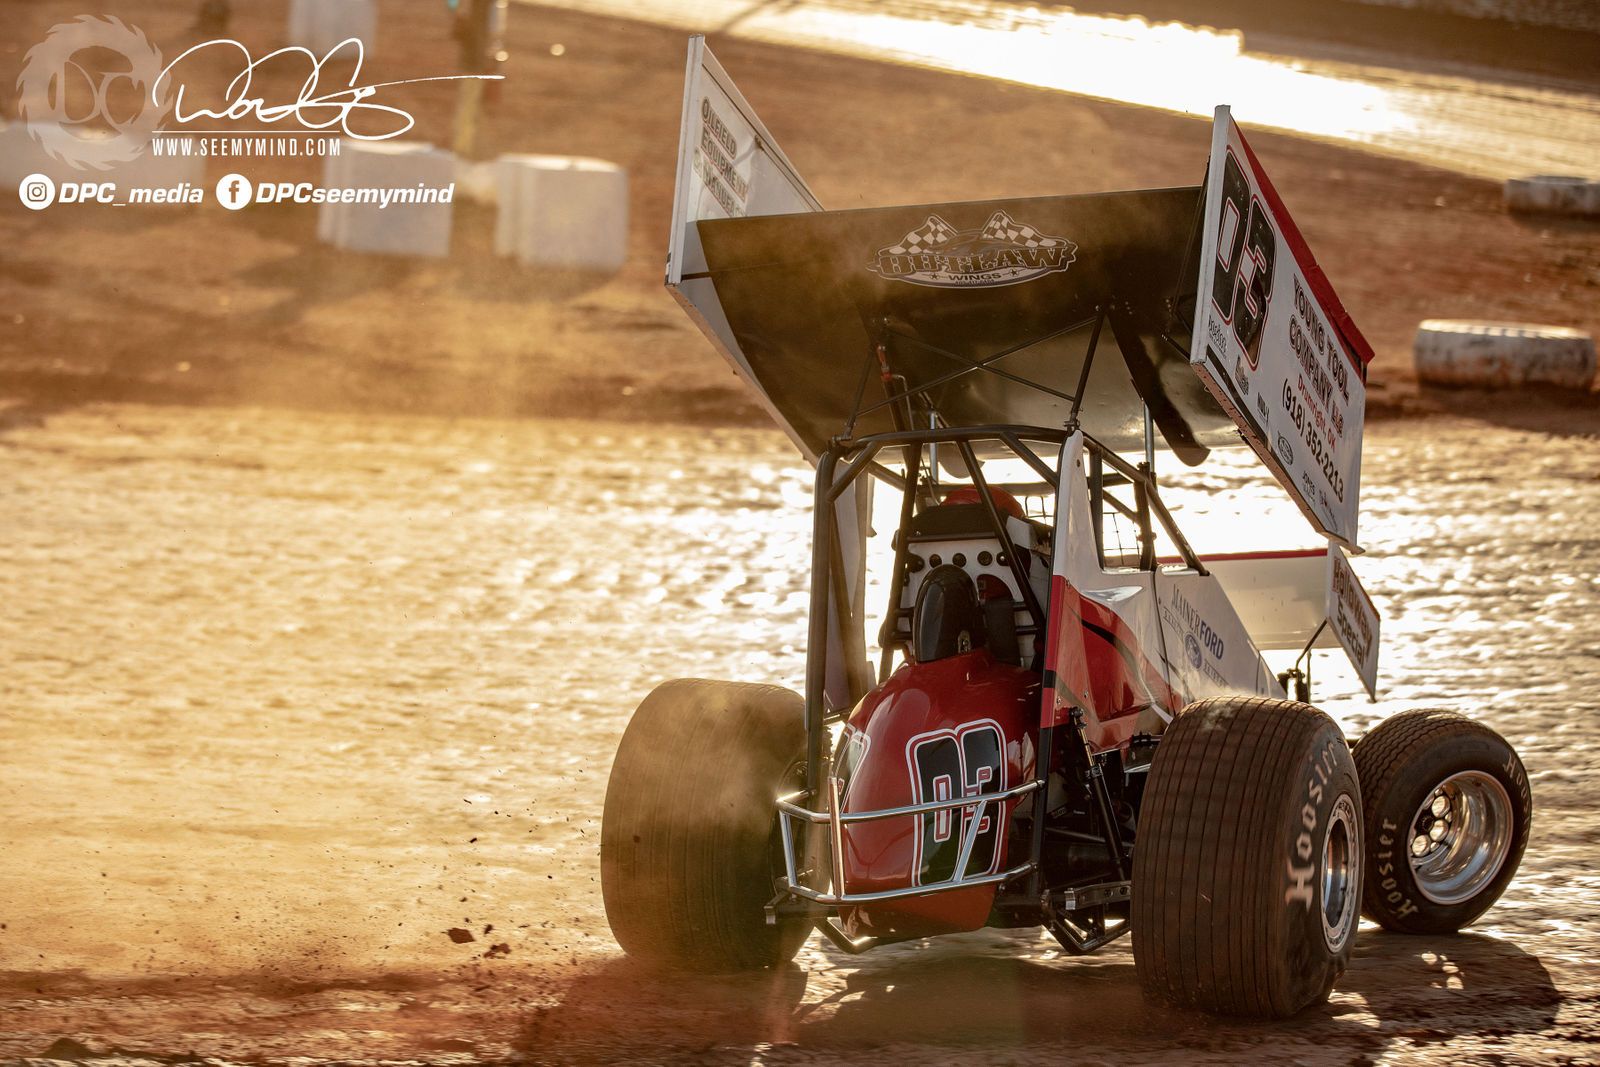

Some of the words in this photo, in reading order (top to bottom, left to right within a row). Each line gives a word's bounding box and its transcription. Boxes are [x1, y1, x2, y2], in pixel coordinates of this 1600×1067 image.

[700, 126, 748, 204] EQUIPMENT
[702, 97, 737, 160] OILFIELD
[948, 272, 1002, 281] WINGS
[1211, 144, 1277, 371] 03
[1289, 314, 1334, 414] COMPANY
[1293, 273, 1325, 356] YOUNG
[1327, 335, 1349, 407] TOOL
[1282, 378, 1306, 437] (918)
[1305, 421, 1344, 504] 352-2213
[1337, 595, 1365, 669] Special
[906, 717, 1008, 888] 03
[1372, 817, 1419, 918] Hoosier
